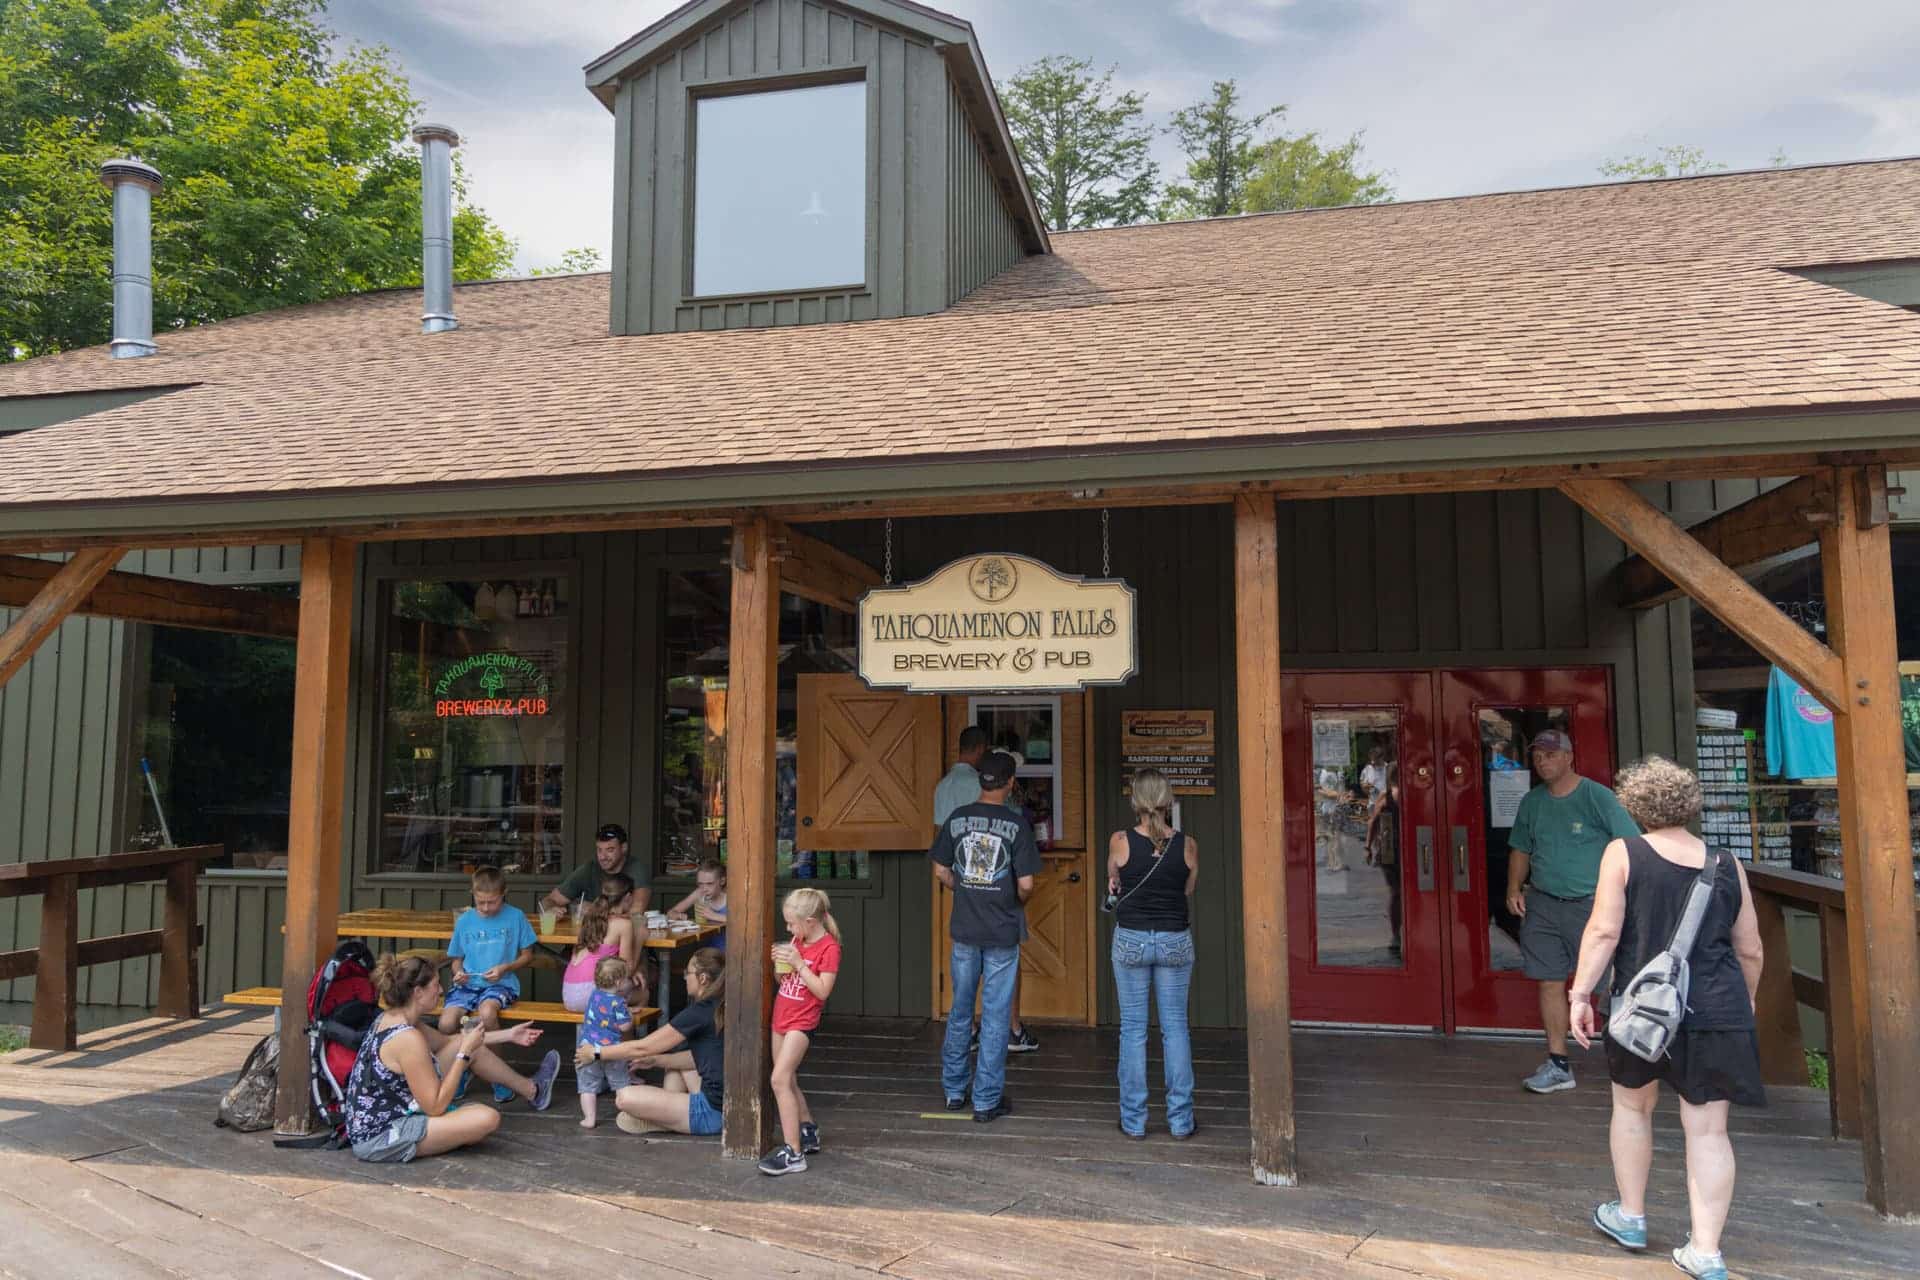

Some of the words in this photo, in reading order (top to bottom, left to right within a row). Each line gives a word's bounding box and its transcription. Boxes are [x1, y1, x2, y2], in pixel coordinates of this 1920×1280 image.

[872, 611, 1041, 646] TAHQUAMENON
[1051, 608, 1116, 637] FALLS
[894, 652, 1006, 670] BREWERY
[1012, 648, 1035, 672] &
[1044, 651, 1091, 667] PUB
[434, 652, 518, 696] TAHQUAMENON
[517, 658, 549, 696] FALLS
[436, 700, 502, 717] BREWERY
[518, 699, 547, 715] PUB
[1127, 755, 1169, 763] RASPBERRY
[1169, 755, 1194, 763] WHEAT
[1195, 755, 1209, 763] ALE
[1178, 767, 1203, 775] STOUT
[1195, 778, 1209, 786] ALE
